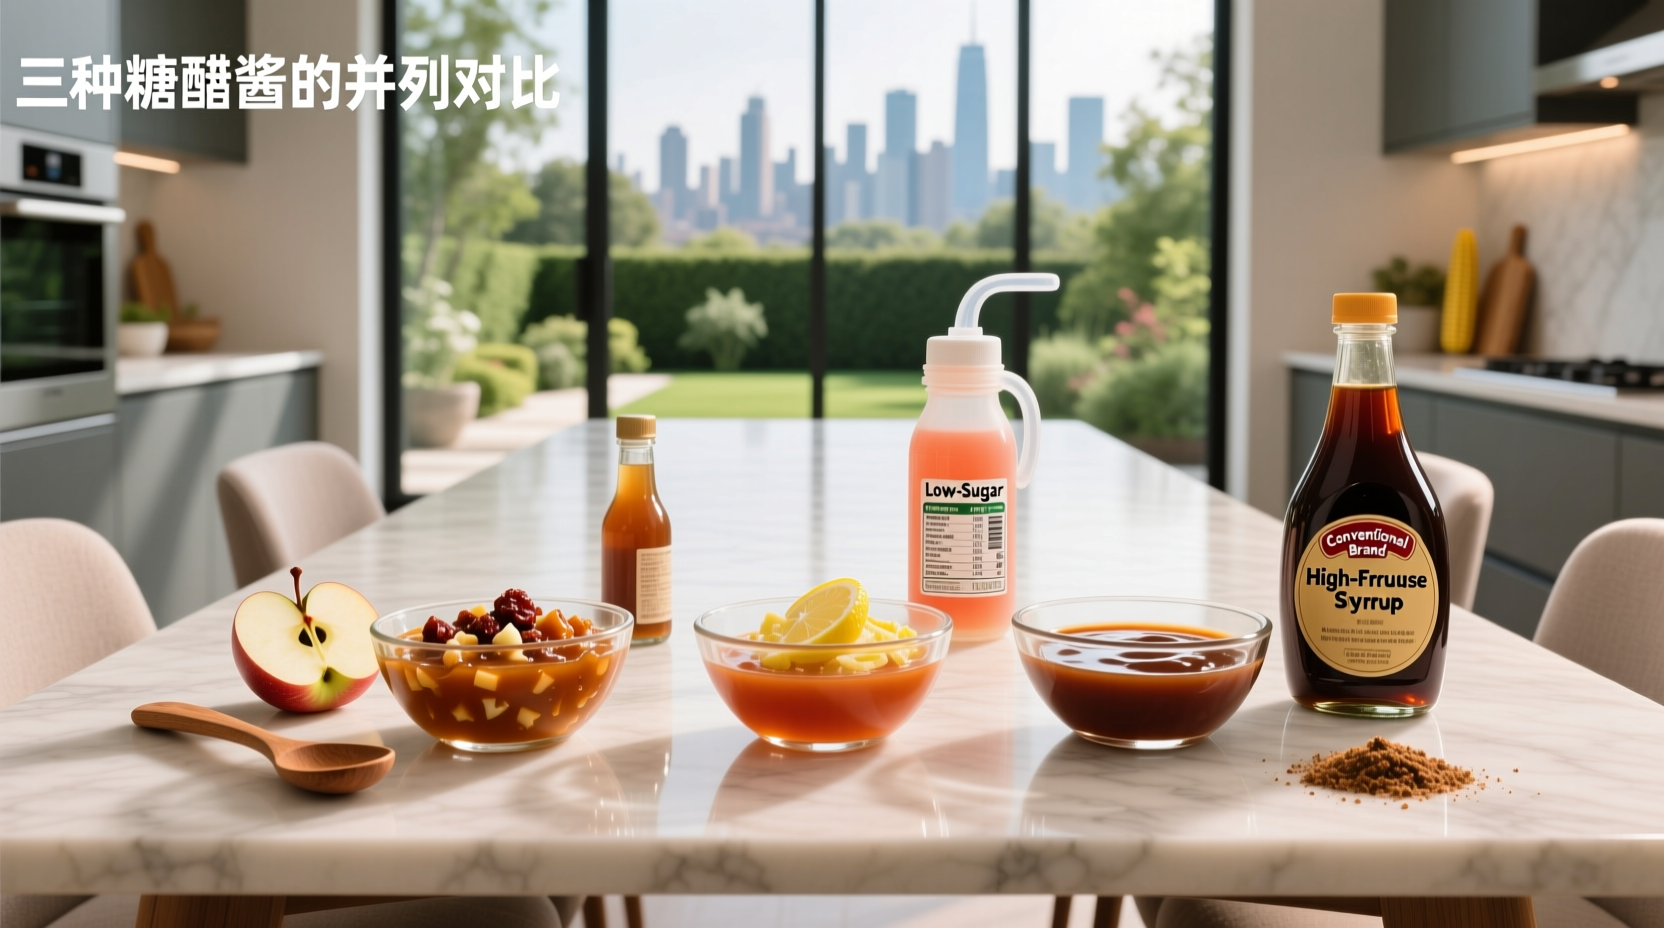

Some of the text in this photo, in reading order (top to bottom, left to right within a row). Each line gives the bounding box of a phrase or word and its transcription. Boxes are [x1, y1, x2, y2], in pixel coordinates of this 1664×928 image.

[925, 482, 1004, 502] Low-Sugar
[1349, 543, 1387, 557] Brand
[1334, 591, 1404, 615] Syrrup
